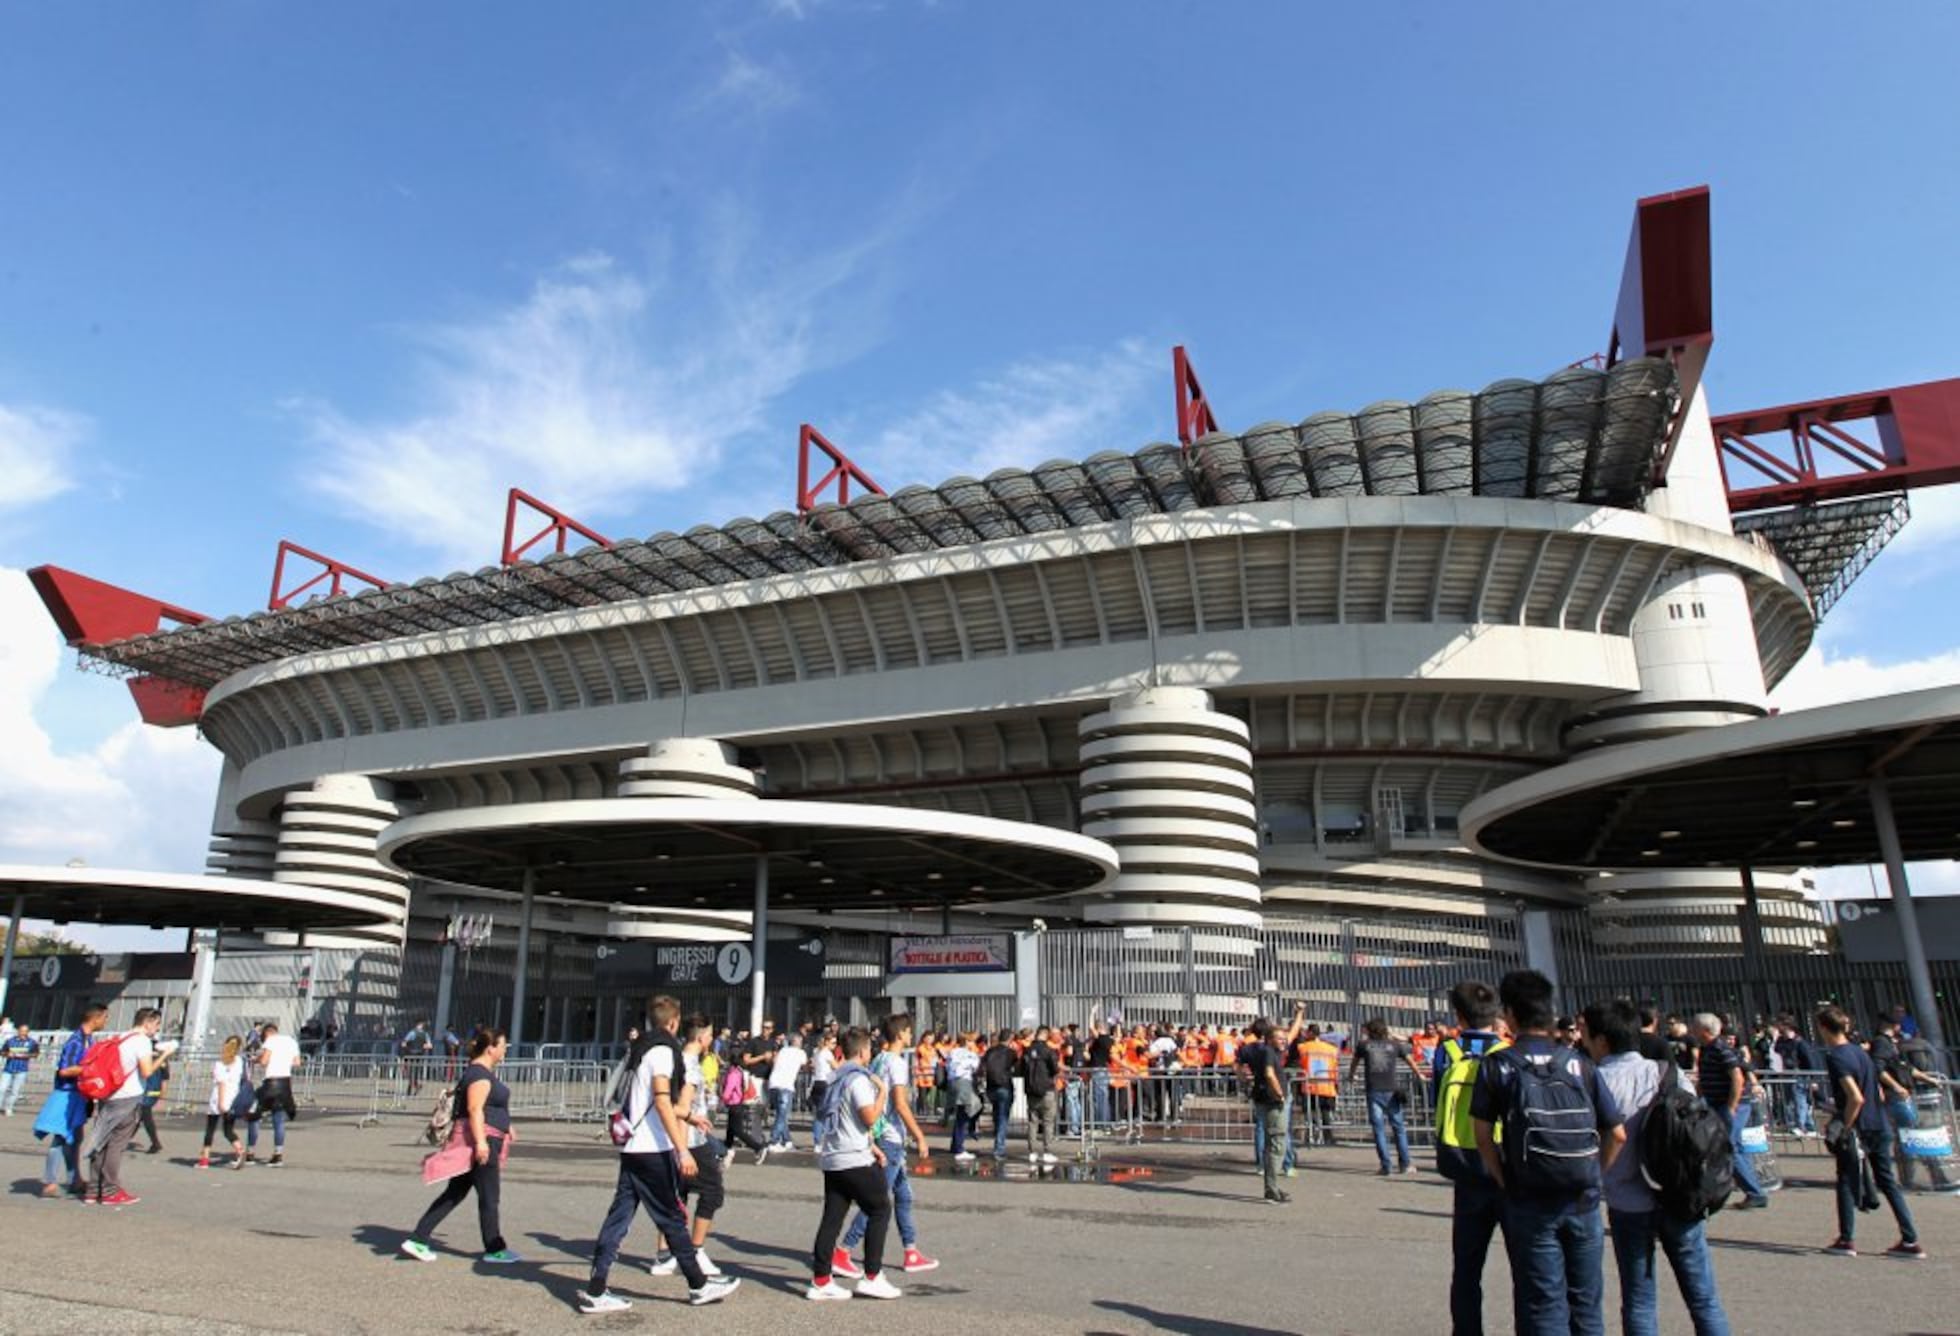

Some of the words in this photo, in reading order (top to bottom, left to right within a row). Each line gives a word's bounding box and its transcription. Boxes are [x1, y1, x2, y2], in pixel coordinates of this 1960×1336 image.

[656, 946, 716, 965] INGRESSO
[728, 948, 741, 979] 9
[670, 965, 700, 981] GATE
